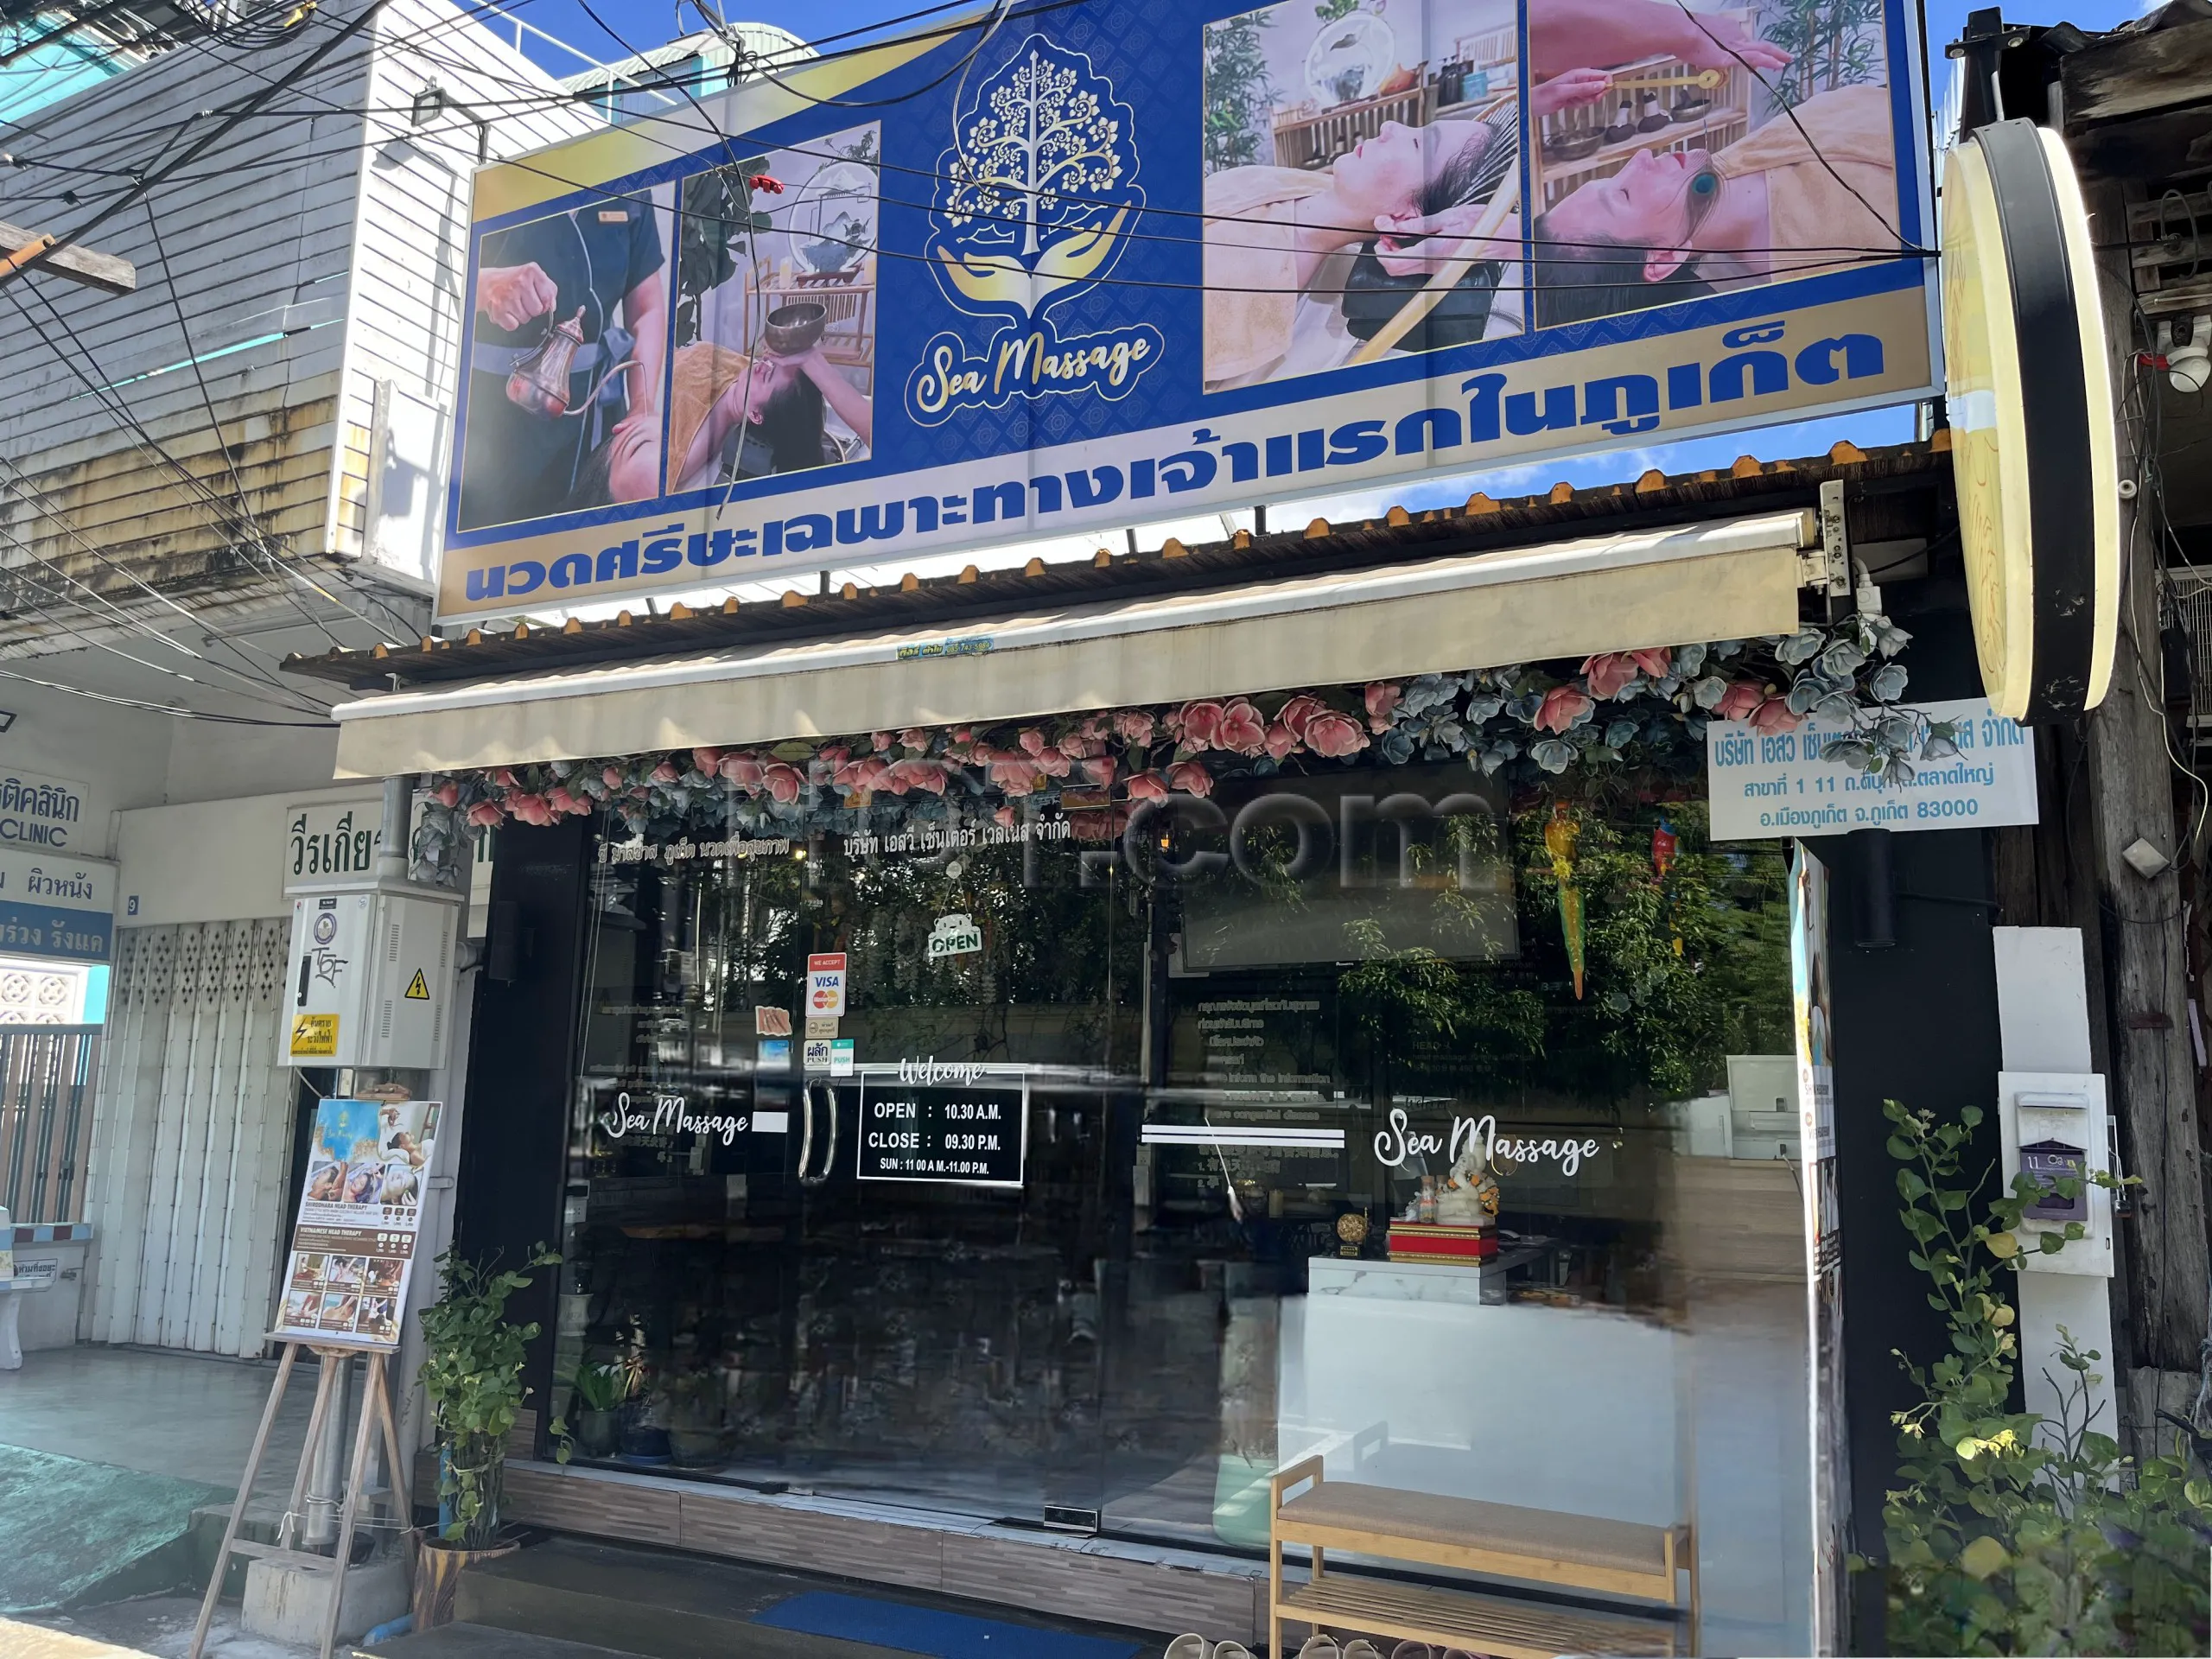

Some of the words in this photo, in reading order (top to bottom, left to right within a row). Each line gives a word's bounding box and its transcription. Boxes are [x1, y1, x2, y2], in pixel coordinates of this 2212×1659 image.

[916, 345, 988, 413] Sea
[994, 331, 1151, 395] Massage
[1761, 732, 1796, 763] เอสว
[1981, 708, 2024, 747] จำกด
[0, 778, 79, 822] ติคลินิก
[1744, 772, 1788, 798] สาขาที่
[1796, 778, 1804, 794] 1
[1816, 776, 1835, 793] 11
[1035, 812, 1071, 841] จำกัด
[1760, 803, 1847, 829] อ.เมืองภูเก็ต
[1855, 799, 1909, 826] จ.ภูเก็ต
[1916, 798, 1979, 818] 83000
[0, 818, 67, 848] CLINIC
[28, 868, 92, 899] ผิวหนัง
[129, 899, 136, 912] 9
[0, 916, 41, 946] ร่วง
[51, 919, 103, 952] รังแค
[932, 933, 978, 953] OPEN
[814, 976, 840, 988] VISA
[807, 1042, 828, 1057] ผลัก
[899, 1055, 986, 1086] Welcome
[606, 1092, 650, 1138] Sea
[652, 1096, 749, 1147] Massage
[874, 1103, 916, 1119] OPEN
[944, 1103, 974, 1120] 10.30
[976, 1104, 1001, 1120] A.M.
[868, 1132, 920, 1148] CLOSE
[944, 1134, 975, 1150] 09.30
[977, 1135, 1001, 1151] P.M.
[1374, 1108, 1443, 1166] Sea
[1448, 1115, 1600, 1177] Massage
[880, 1157, 899, 1170] SUN
[972, 1161, 989, 1175] P.M.
